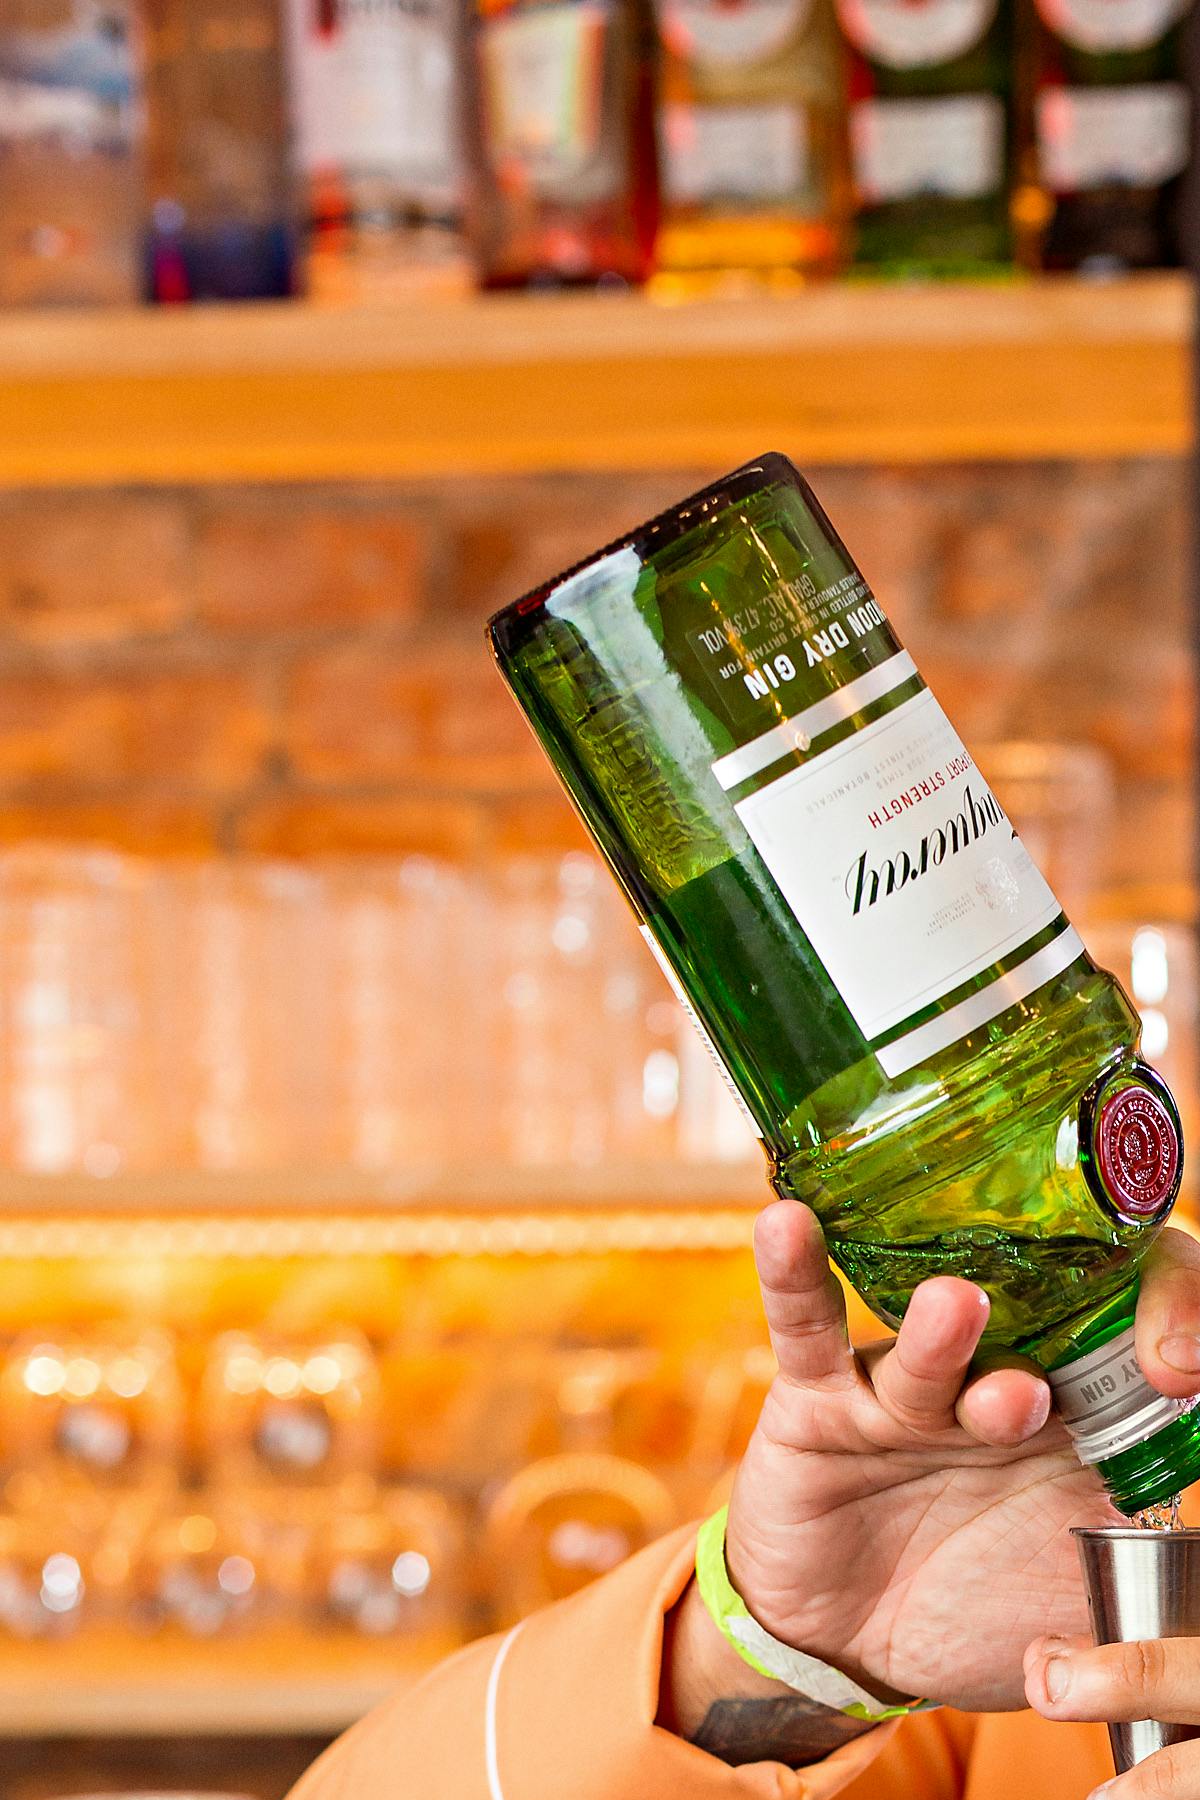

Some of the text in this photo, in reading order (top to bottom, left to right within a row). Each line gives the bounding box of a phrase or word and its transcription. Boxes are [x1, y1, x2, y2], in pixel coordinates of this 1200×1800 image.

[818, 607, 831, 620] IN
[828, 587, 858, 615] BOTTLED
[698, 626, 729, 655] VOL
[743, 598, 888, 701] NDON DRY GIN
[718, 657, 743, 680] FOR
[867, 771, 946, 829] STRENGTH
[1080, 1358, 1143, 1404] RY GIN
